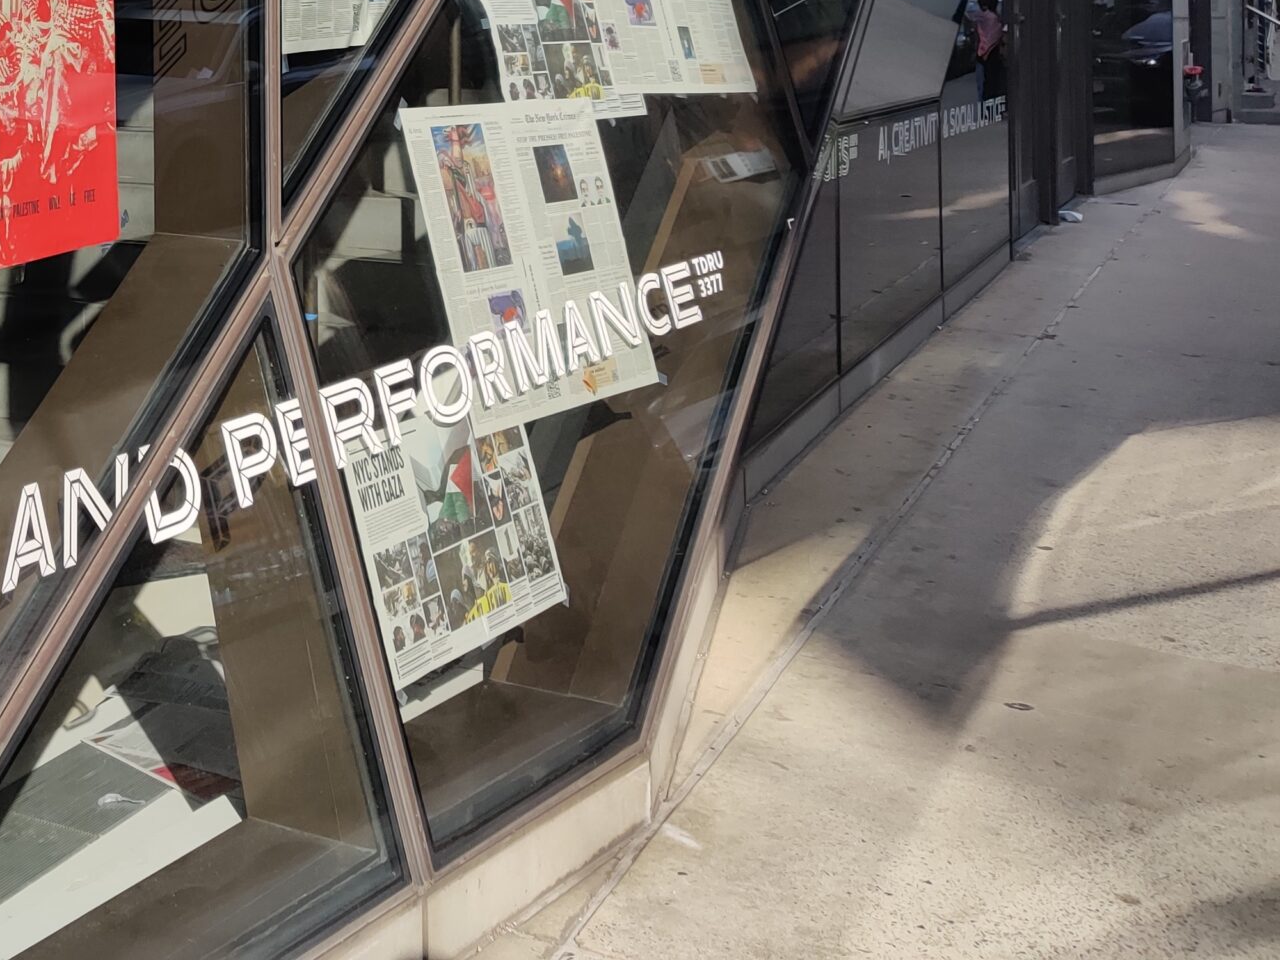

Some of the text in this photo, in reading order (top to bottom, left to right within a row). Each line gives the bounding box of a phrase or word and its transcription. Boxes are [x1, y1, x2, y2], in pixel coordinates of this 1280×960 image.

[12, 199, 40, 219] PALESTINE
[691, 250, 724, 276] TDRU
[698, 272, 724, 298] 3377
[1, 443, 201, 596] AND
[221, 259, 703, 509] PERFORMANCE
[352, 445, 405, 487] NYC STANDS
[357, 478, 405, 513] WITH GAZA
